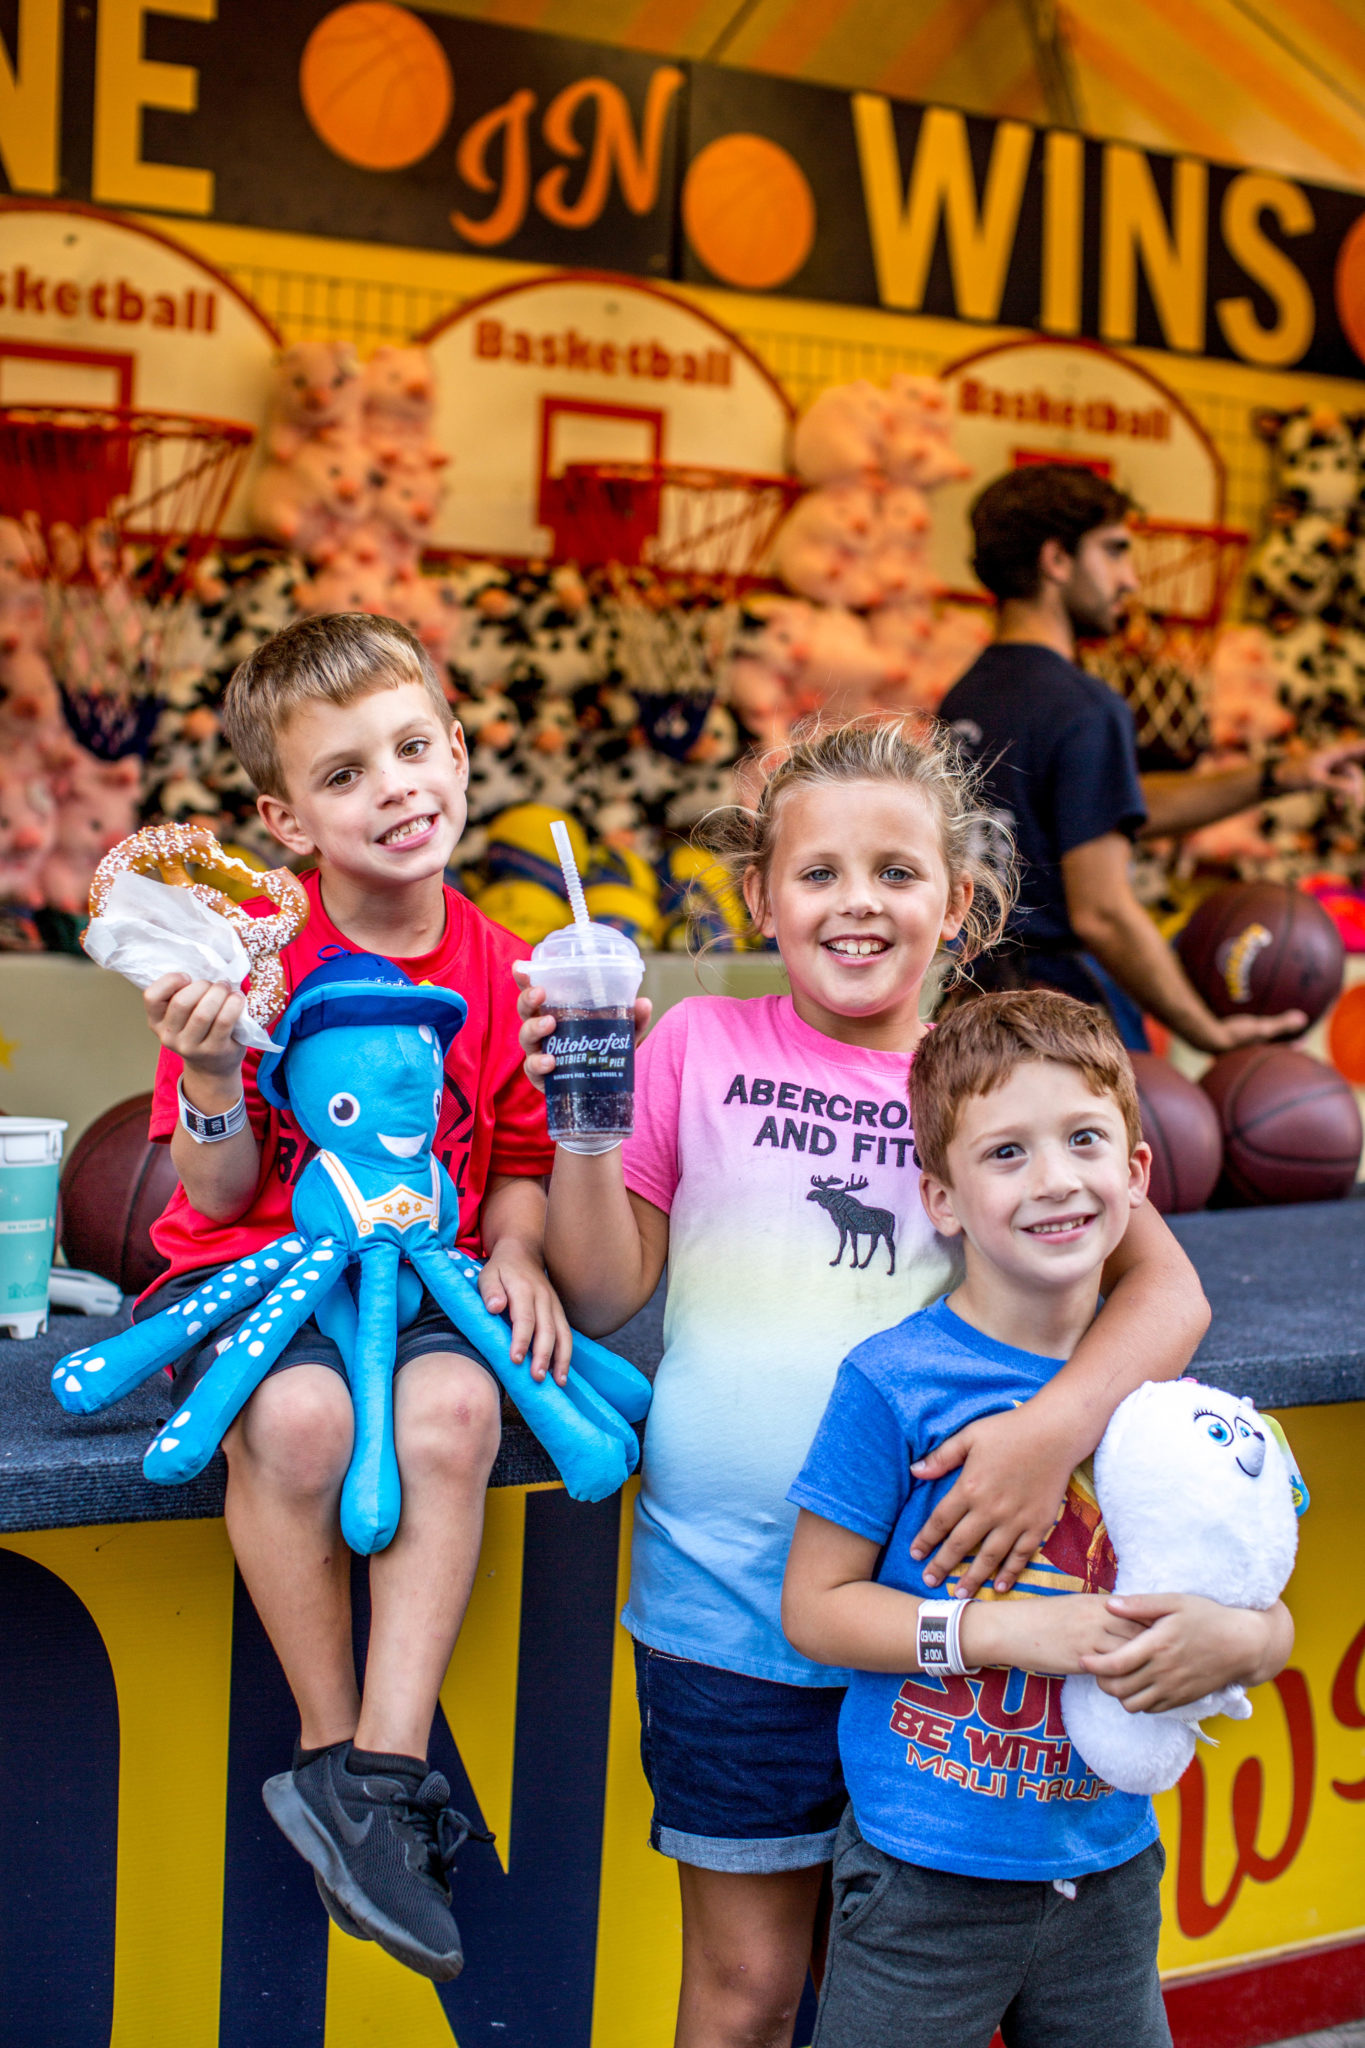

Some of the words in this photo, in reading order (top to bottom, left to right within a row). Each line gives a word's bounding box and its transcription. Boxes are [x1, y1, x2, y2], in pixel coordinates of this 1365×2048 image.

[851, 92, 1316, 368] WINS
[474, 318, 732, 388] Basketball
[960, 377, 1172, 442] Basketball
[546, 1032, 631, 1056] Oktoberfest
[555, 1052, 587, 1067] OOTBIER
[609, 1057, 626, 1068] PIER
[723, 1073, 914, 1130] ABERCRO
[753, 1115, 837, 1157] AND
[899, 1664, 1068, 1739] SU
[889, 1699, 956, 1754] BE
[963, 1725, 1072, 1777] WITH
[906, 1742, 1008, 1799] MAUI
[1017, 1777, 1117, 1803] HAWA
